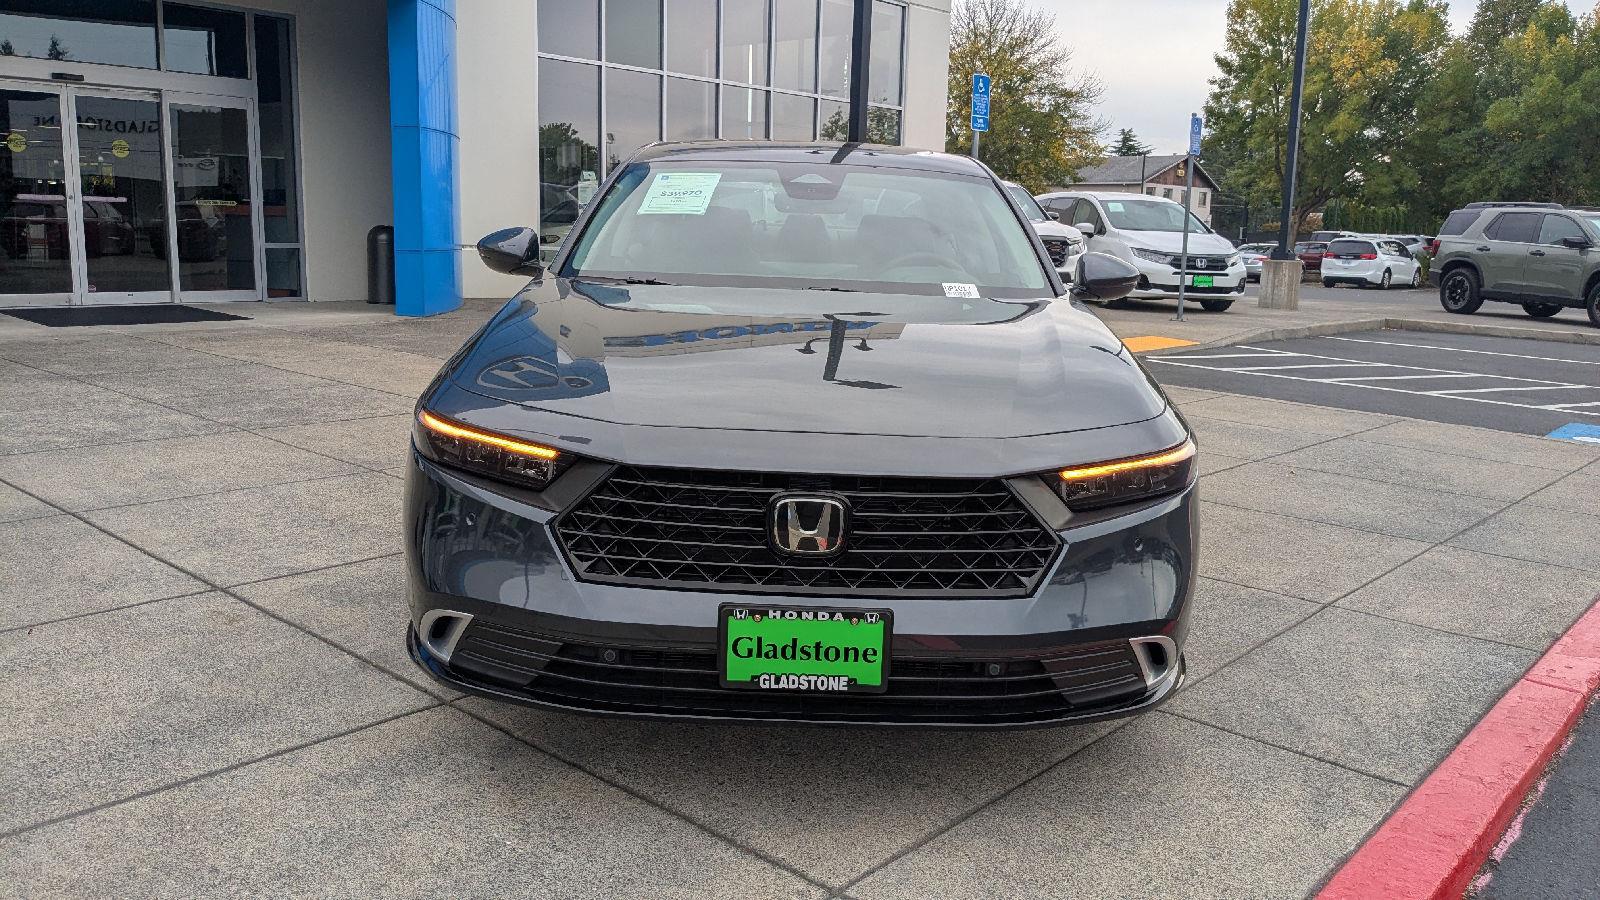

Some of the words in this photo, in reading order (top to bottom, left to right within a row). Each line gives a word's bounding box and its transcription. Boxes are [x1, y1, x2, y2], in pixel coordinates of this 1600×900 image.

[768, 609, 845, 622] HONDA
[731, 636, 878, 663] Gladstone
[759, 674, 849, 691] GLADSTONE
